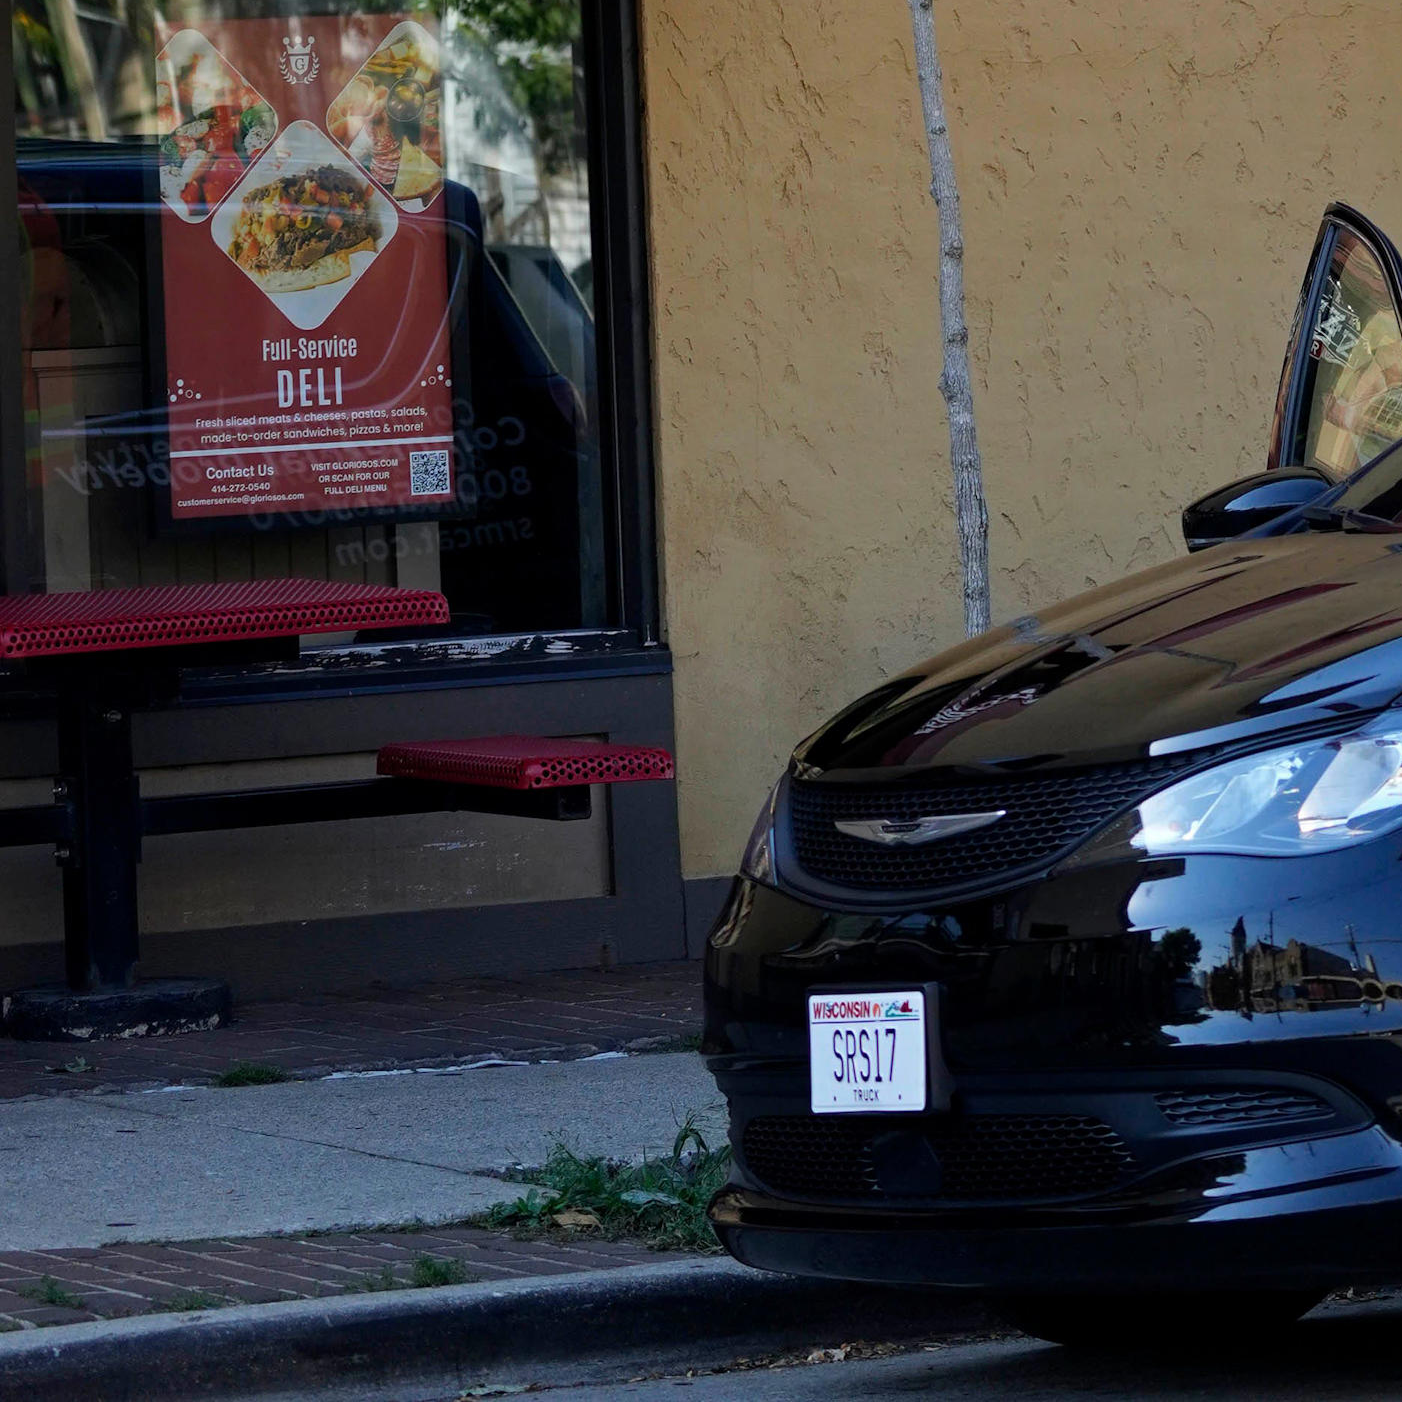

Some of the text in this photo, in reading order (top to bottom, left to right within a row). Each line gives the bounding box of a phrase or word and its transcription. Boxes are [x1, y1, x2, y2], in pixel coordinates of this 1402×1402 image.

[262, 335, 358, 362] Full-Service
[277, 366, 343, 408] DELI
[195, 406, 428, 428] Fresh sliced meats & cheeses, pastas, salads,
[200, 422, 424, 444] made-to-order sandwiches, pizzas & more!
[206, 464, 275, 480] Contact Us
[311, 458, 399, 472] VISIT GLORIOSOS.COM
[318, 471, 390, 484] OR SCAN FOR OUR
[211, 482, 271, 494] 414-272-0540
[324, 484, 388, 496] FULL DELI MENU
[177, 493, 305, 508] customerservice@gloriosos.com
[812, 1001, 871, 1019] WISCONSIN
[832, 1029, 896, 1083] SRS17
[852, 1089, 880, 1102] TRUCK
